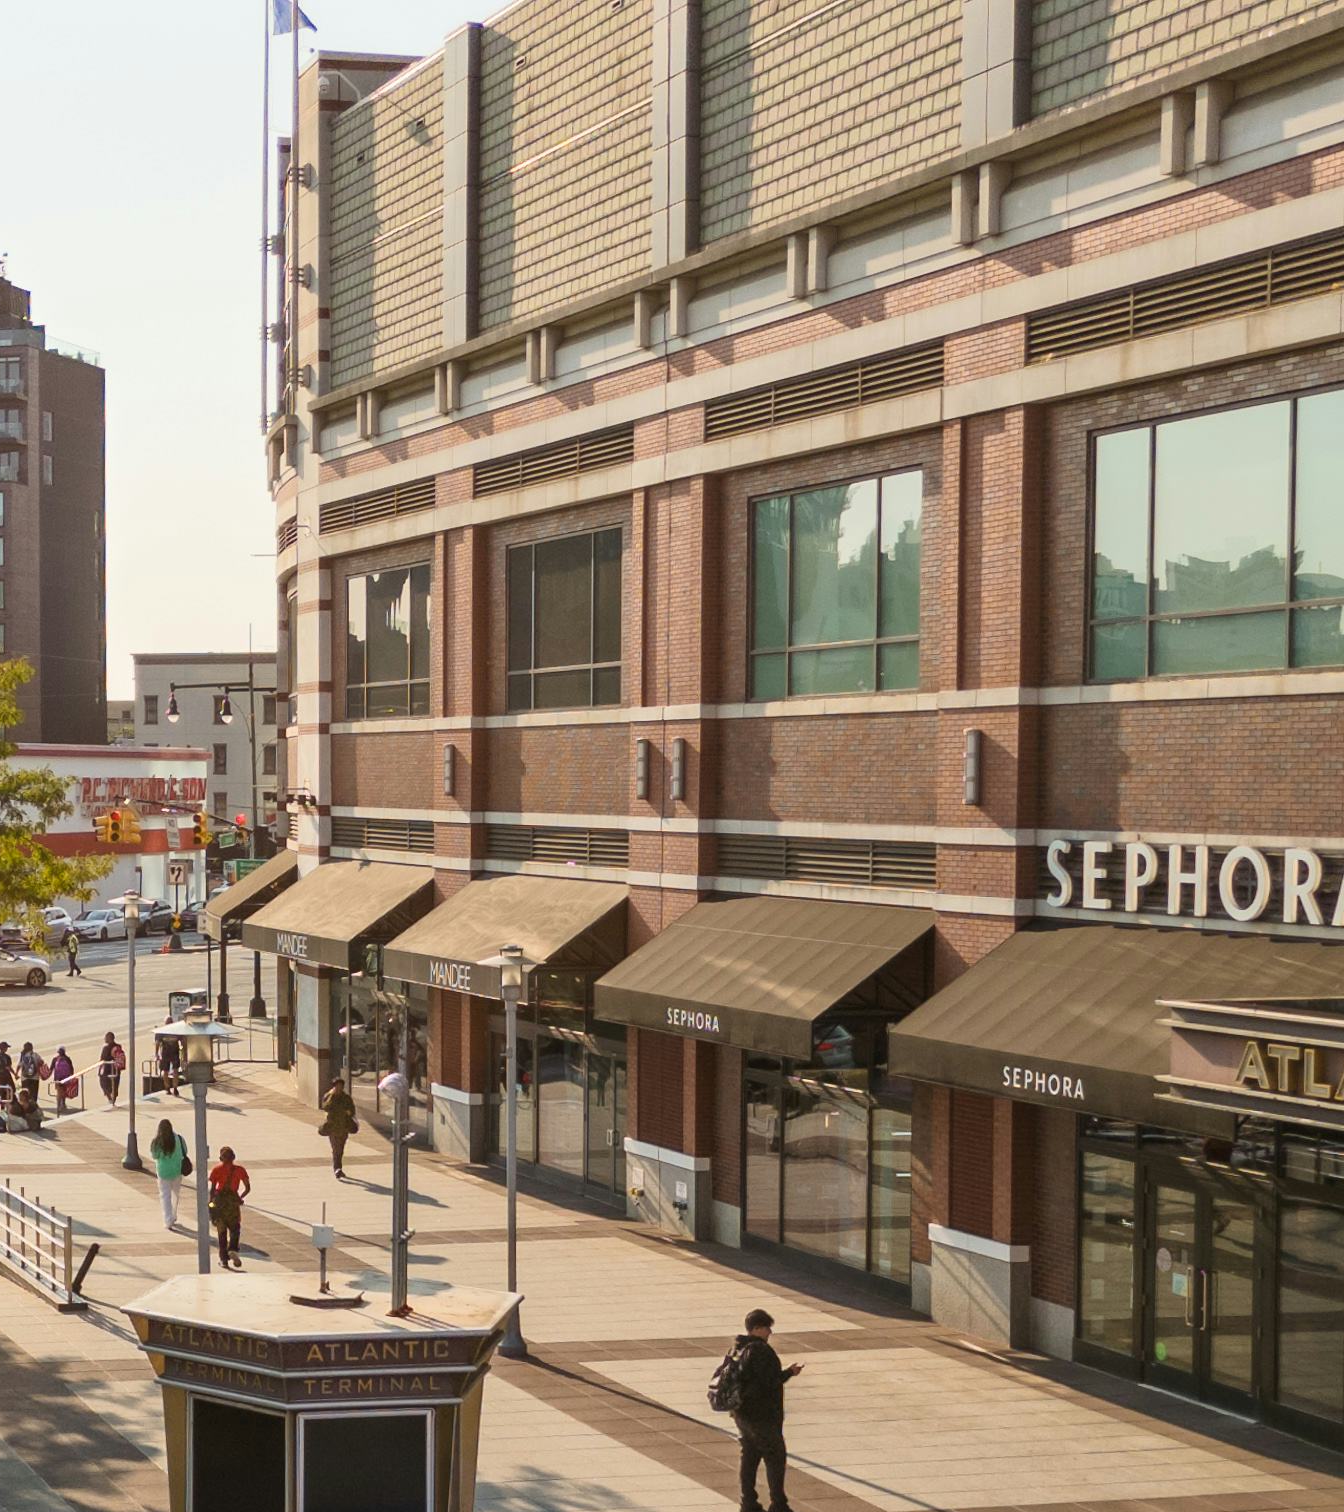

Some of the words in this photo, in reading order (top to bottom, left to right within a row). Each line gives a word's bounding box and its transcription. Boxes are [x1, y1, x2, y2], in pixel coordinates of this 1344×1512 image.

[429, 960, 471, 991] MANDEE
[666, 1006, 720, 1034] SEPHORA
[1002, 1065, 1085, 1101] SEPHORA
[161, 1323, 269, 1360] ATLANTIC
[307, 1340, 449, 1363] ATLANTIC
[172, 1357, 276, 1394] TERMINAL
[303, 1374, 441, 1395] TERMINAL
